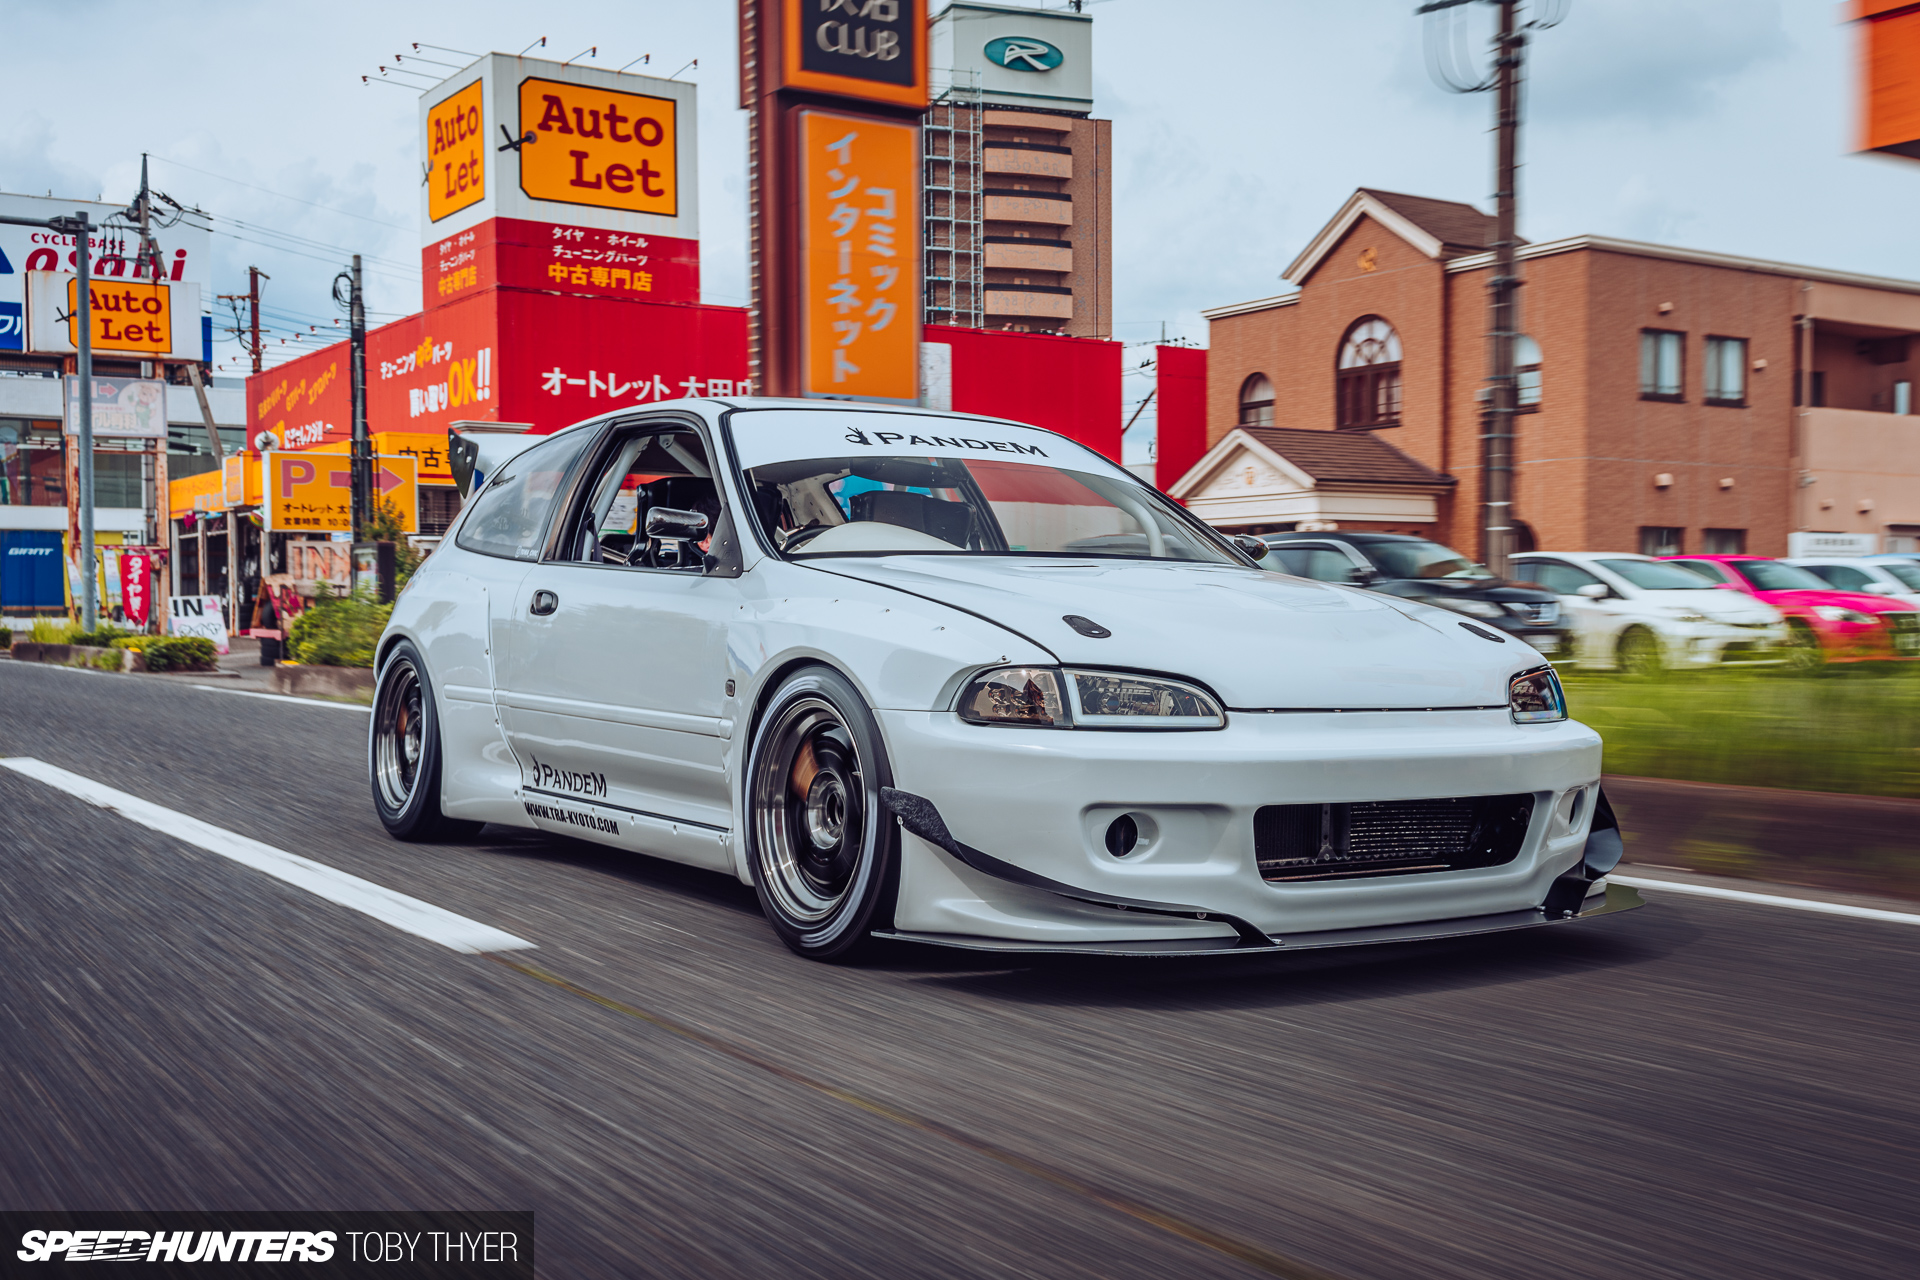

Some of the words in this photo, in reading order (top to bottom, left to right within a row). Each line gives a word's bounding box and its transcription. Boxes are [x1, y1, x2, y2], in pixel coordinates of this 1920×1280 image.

[816, 21, 900, 61] CLUB
[434, 104, 479, 155] Auto
[537, 94, 664, 147] Auto
[445, 149, 480, 199] Let
[569, 150, 665, 198] Let
[31, 233, 77, 246] CYCLE
[826, 131, 863, 383] インターネット
[864, 187, 899, 332] コミック
[548, 262, 653, 292] 中古専門店
[89, 288, 162, 315] Auto
[100, 318, 163, 343] Let
[541, 367, 671, 401] オートレット
[872, 431, 1050, 458] PANDEM
[281, 459, 316, 498] P
[8, 548, 54, 556] GIANT
[172, 598, 204, 617] IN
[541, 763, 607, 797] PANDEM
[524, 802, 620, 835] WWW.TRA-KYOTO.COM
